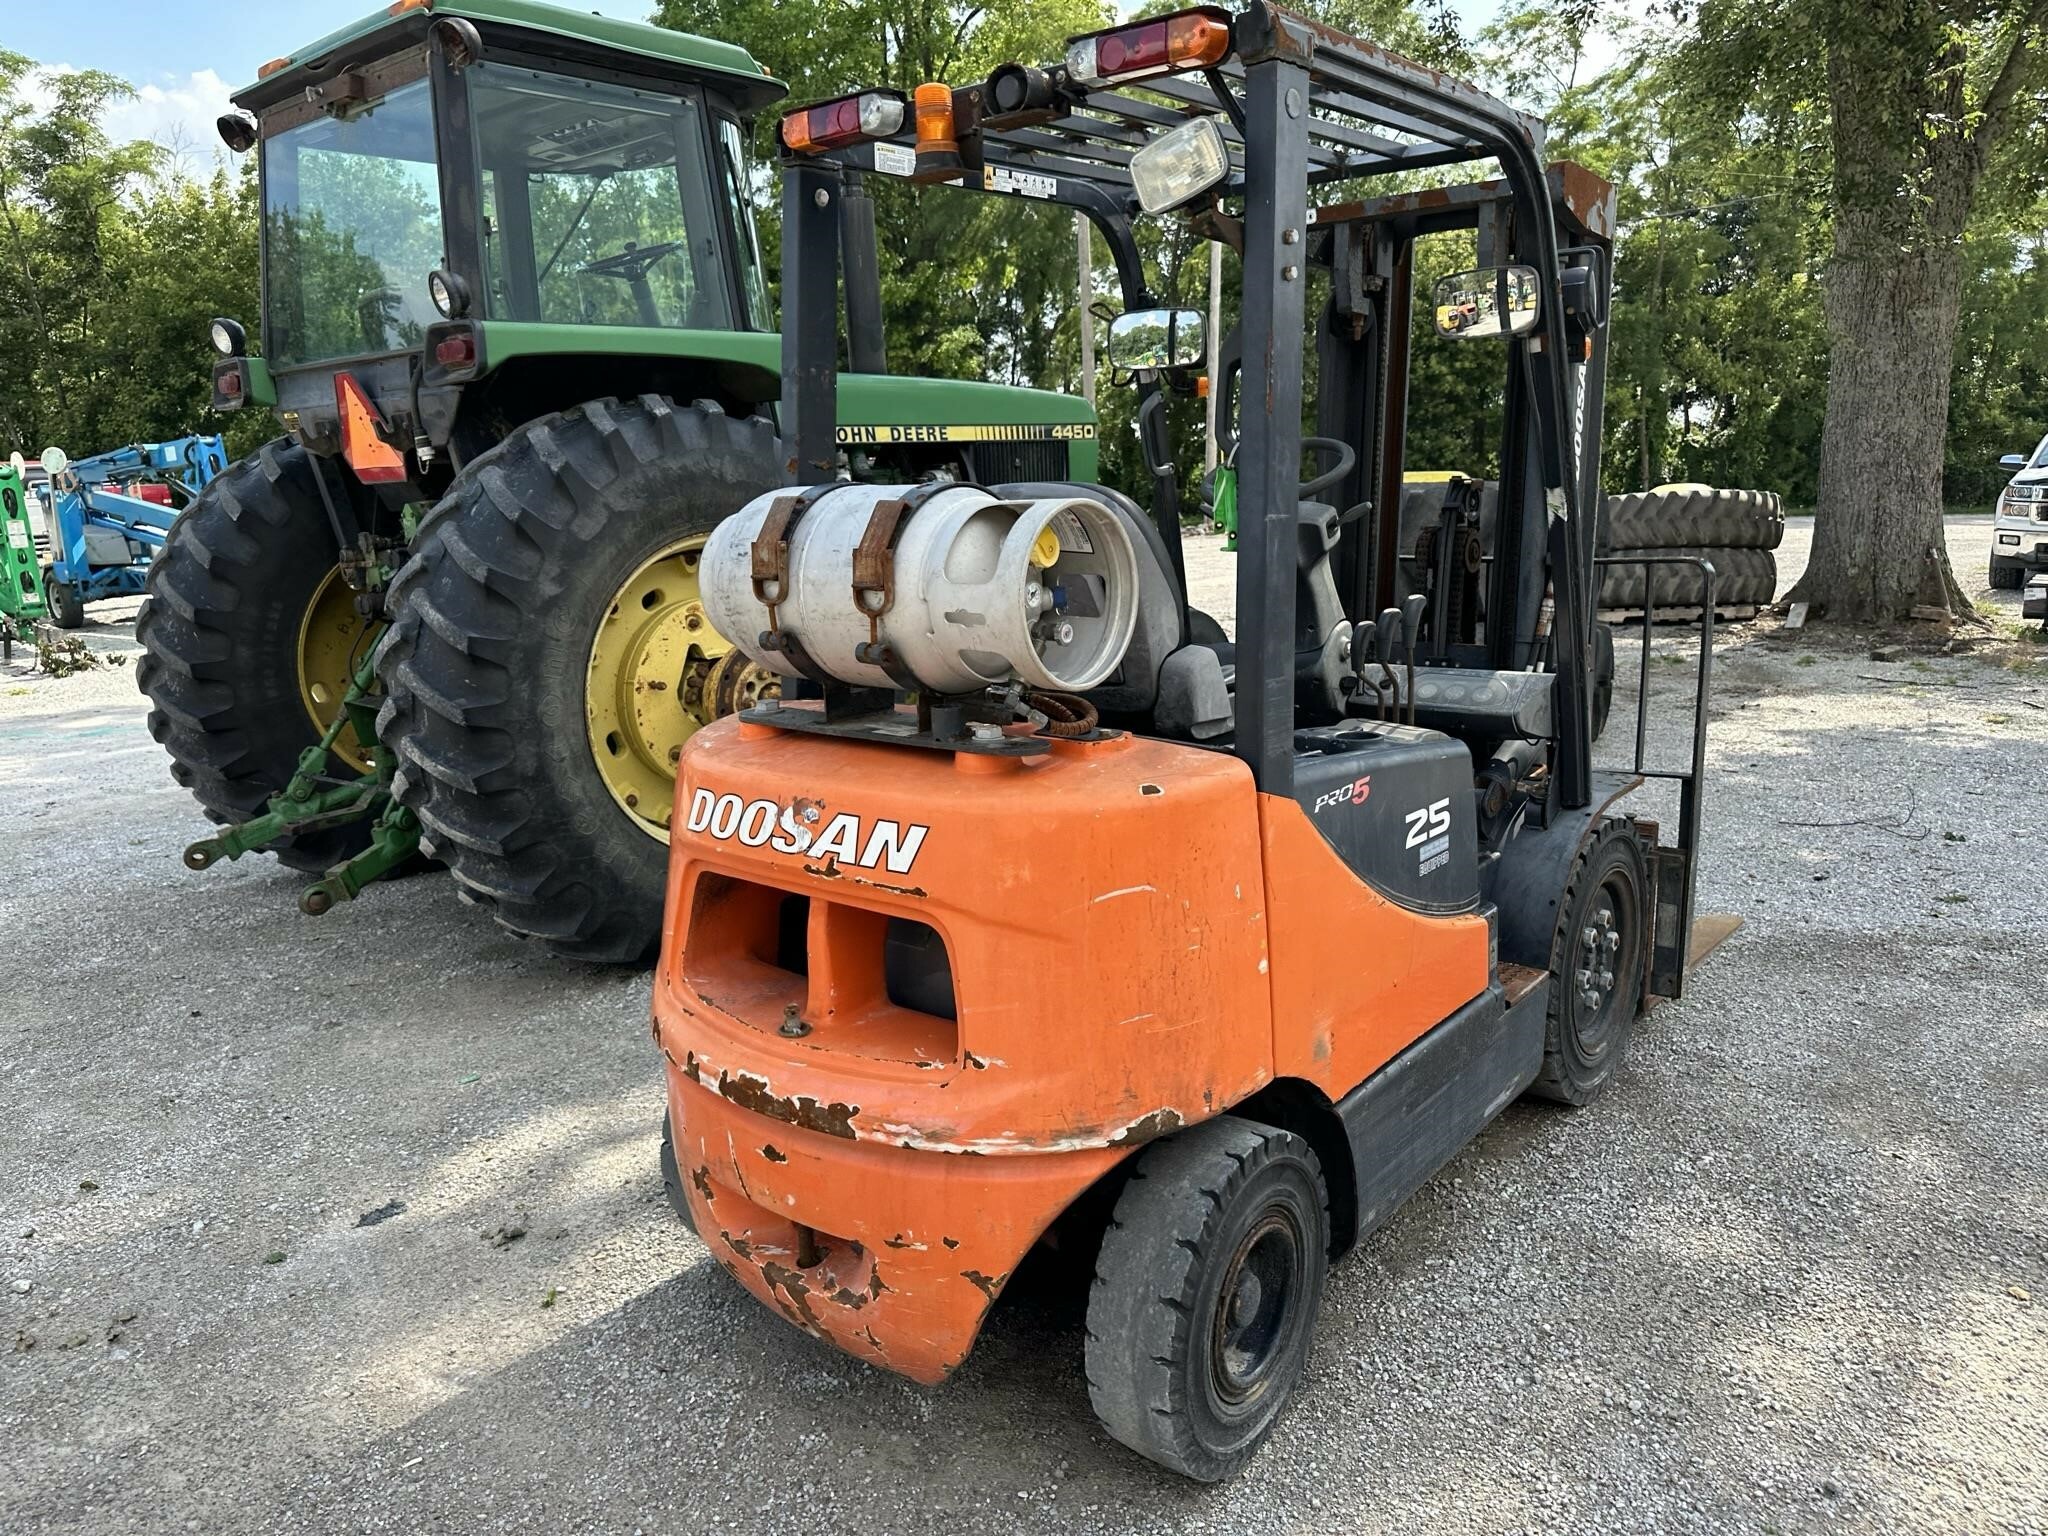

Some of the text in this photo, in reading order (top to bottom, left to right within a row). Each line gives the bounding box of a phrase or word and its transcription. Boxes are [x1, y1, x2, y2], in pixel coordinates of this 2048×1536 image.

[836, 426, 949, 442] OHN DEERE
[1052, 424, 1094, 439] 4450
[1314, 775, 1371, 814] PRO5
[687, 787, 930, 874] DOOSAN
[1405, 797, 1451, 850] 25
[1419, 850, 1450, 877] EQUIPPED
